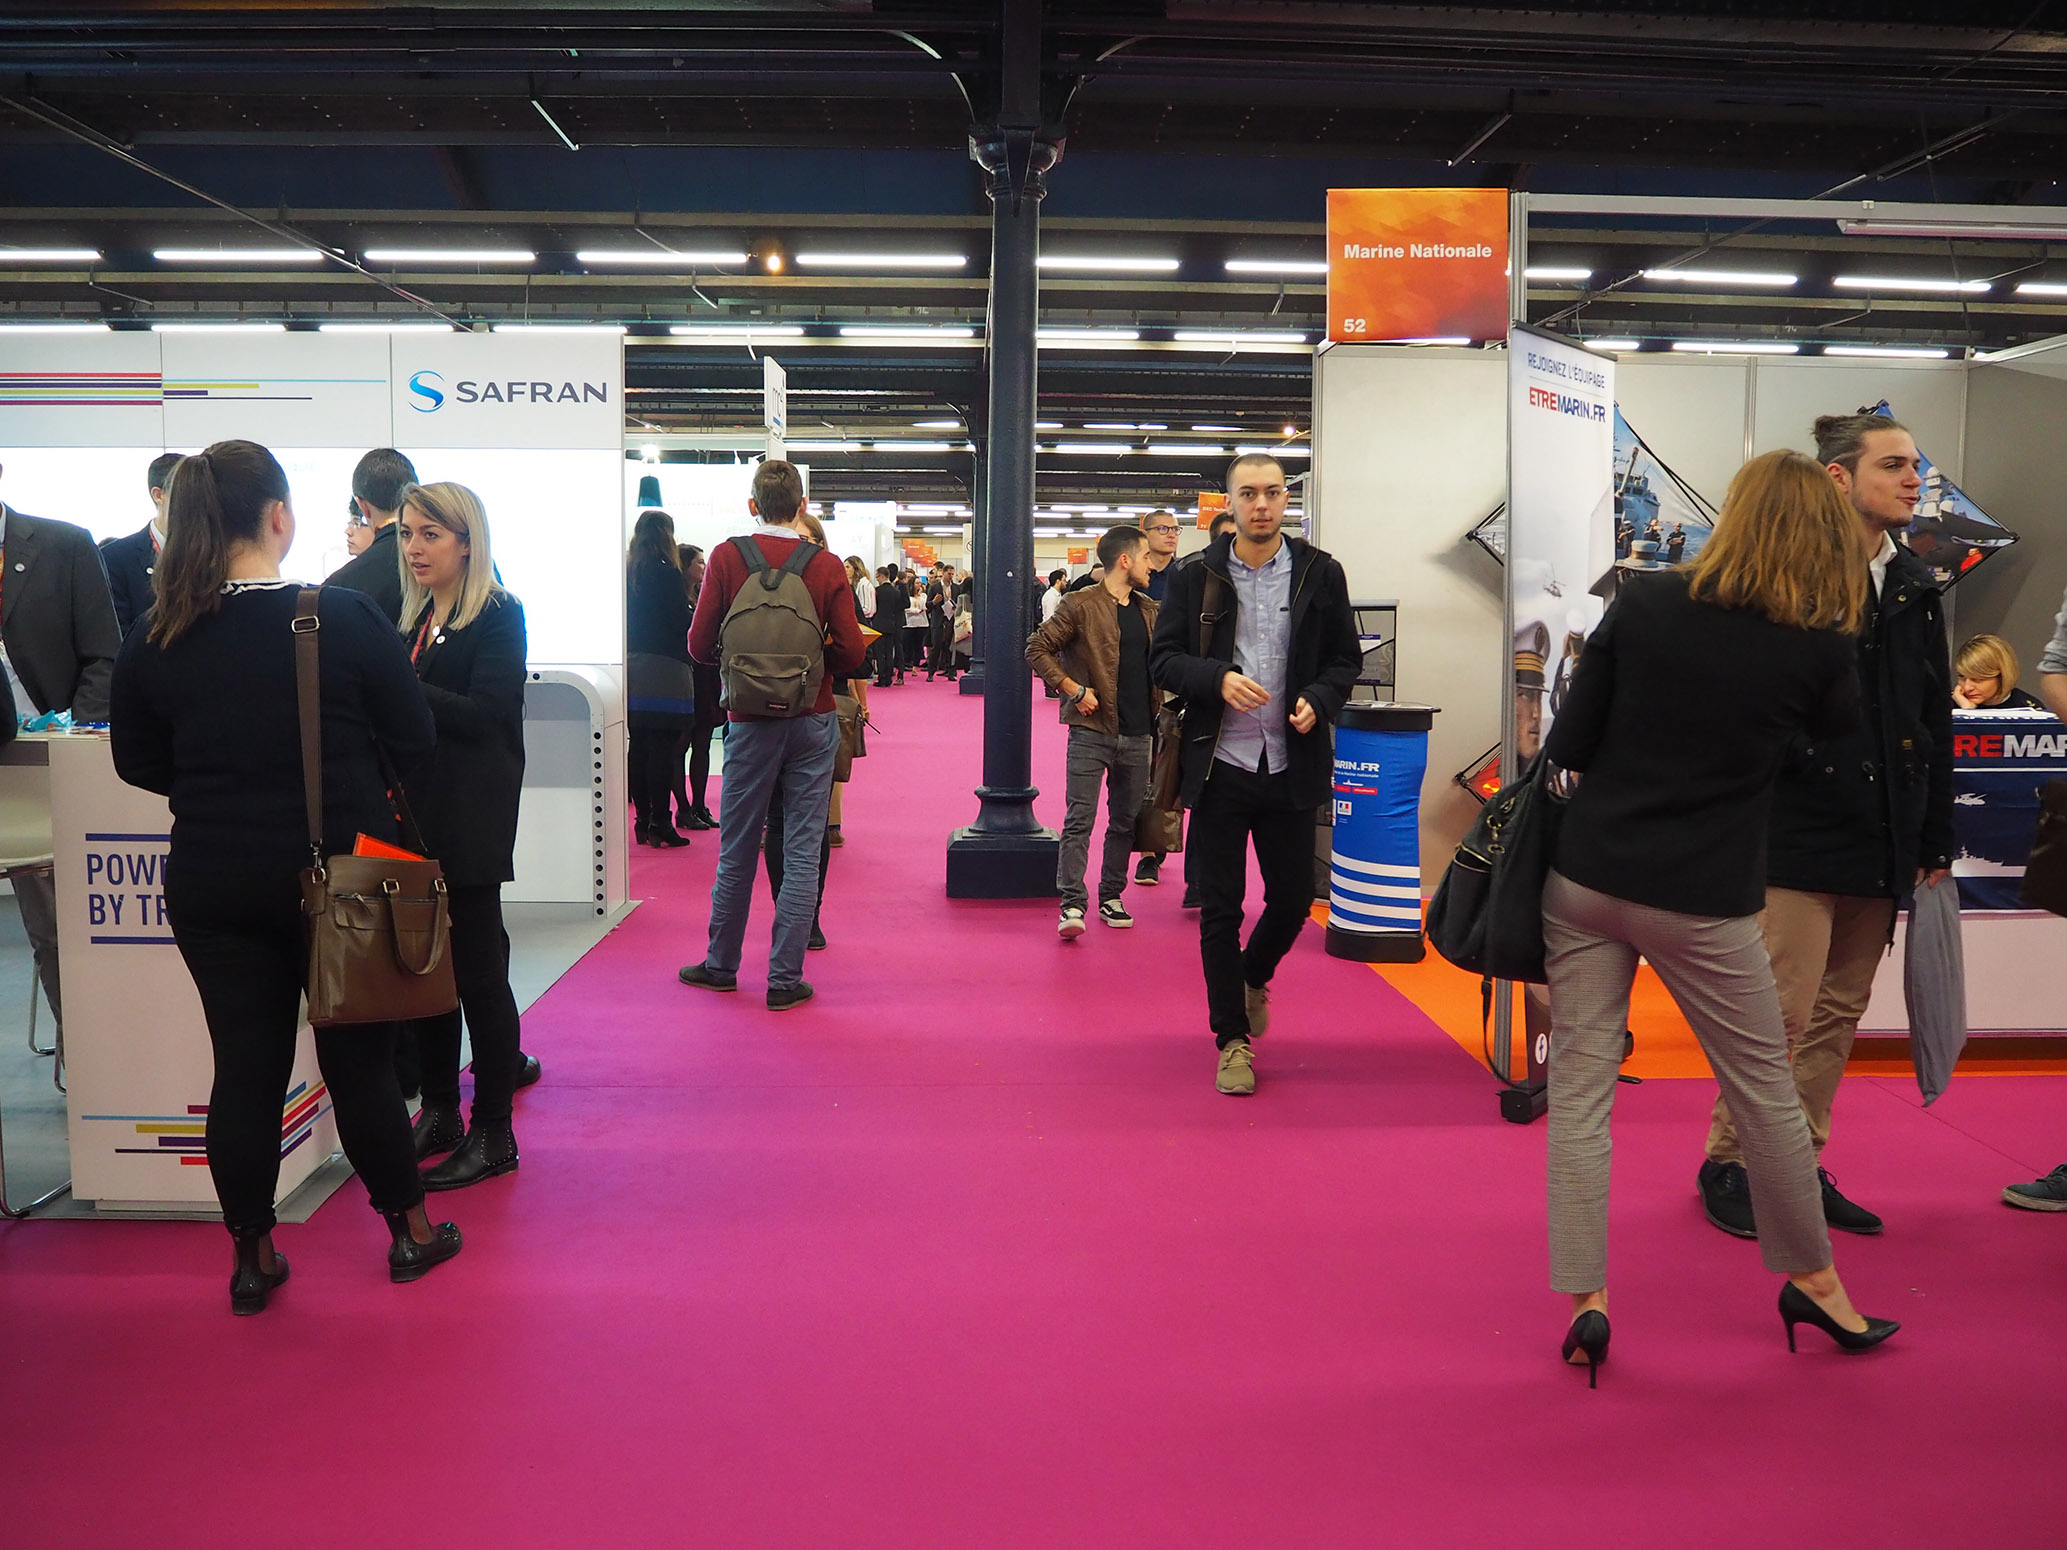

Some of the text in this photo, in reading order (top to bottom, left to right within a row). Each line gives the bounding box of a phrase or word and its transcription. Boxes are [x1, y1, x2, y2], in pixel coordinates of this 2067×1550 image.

[1344, 243, 1492, 259] Marine Nationale
[1343, 318, 1366, 333] 52
[1527, 352, 1605, 389] REJOIGNEZ L'ÉQUIPAGE
[456, 381, 607, 403] SAFRAN
[1529, 386, 1606, 423] ETREMARIN.FR
[88, 894, 172, 926] BY TR
